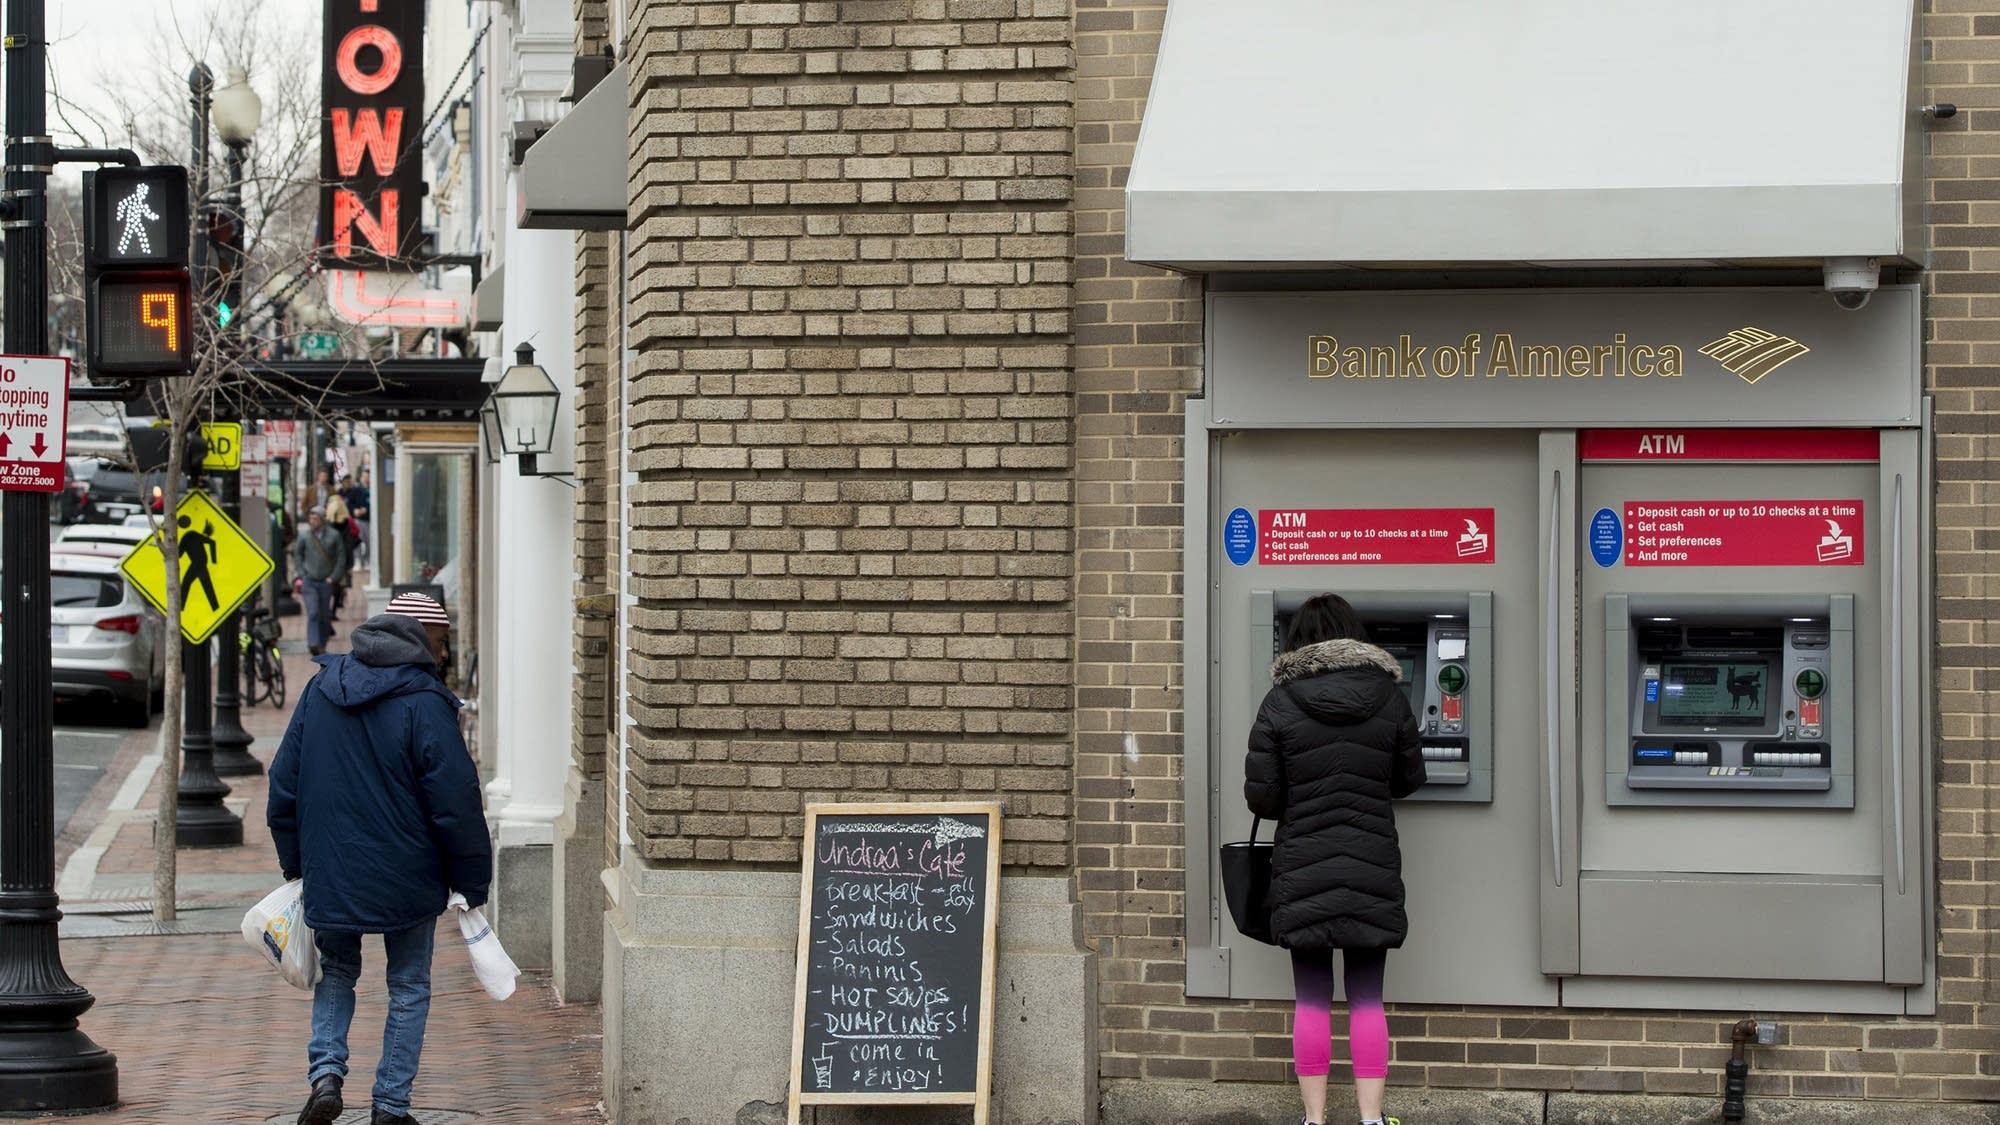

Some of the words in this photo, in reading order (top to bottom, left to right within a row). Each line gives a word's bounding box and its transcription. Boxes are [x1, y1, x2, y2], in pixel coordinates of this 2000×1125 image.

[331, 0, 404, 257] OWN
[142, 293, 176, 352] 9
[1308, 334, 1428, 378] Bank
[1432, 333, 1481, 378] of
[1485, 333, 1684, 378] America
[0, 364, 16, 383] o
[0, 386, 49, 409] opping
[1637, 434, 1685, 454] ATM
[11, 464, 41, 476] Zone
[1, 475, 55, 486] 202.727.5000
[1272, 512, 1307, 527] ATM
[1638, 506, 1678, 519] Deposit
[1680, 507, 1706, 517] cash
[1708, 508, 1720, 516] or
[1723, 508, 1736, 519] up
[1739, 506, 1750, 516] to
[1752, 506, 1766, 516] 10
[1769, 506, 1806, 516] checks
[1808, 506, 1820, 516] at
[1822, 507, 1829, 516] a
[1832, 506, 1856, 516] time
[1271, 530, 1304, 539] Deposit
[1306, 530, 1327, 538] cash
[1340, 531, 1351, 539] up
[1353, 530, 1363, 538] to
[1364, 529, 1376, 538] 10
[1378, 529, 1408, 538] checks
[1429, 529, 1449, 537] time
[1638, 521, 1657, 531] Get
[1659, 521, 1684, 531] cash
[1271, 541, 1287, 550] Get
[1289, 541, 1309, 550] cash
[1638, 535, 1657, 546] Set
[1659, 536, 1722, 548] preferences
[1271, 552, 1287, 561] Set
[1288, 552, 1340, 562] preferences
[1342, 552, 1358, 561] and
[1638, 550, 1658, 561] And
[1661, 552, 1688, 561] more
[818, 837, 914, 870] Undraa's
[919, 838, 966, 880] Café
[824, 878, 925, 909] Breakfast
[950, 876, 975, 893] all
[944, 893, 975, 915] day
[824, 904, 957, 934] Sandwiches
[829, 931, 906, 958] Salads
[833, 957, 923, 983] Paninis
[831, 984, 878, 1009] HOT
[918, 1041, 941, 1062] in
